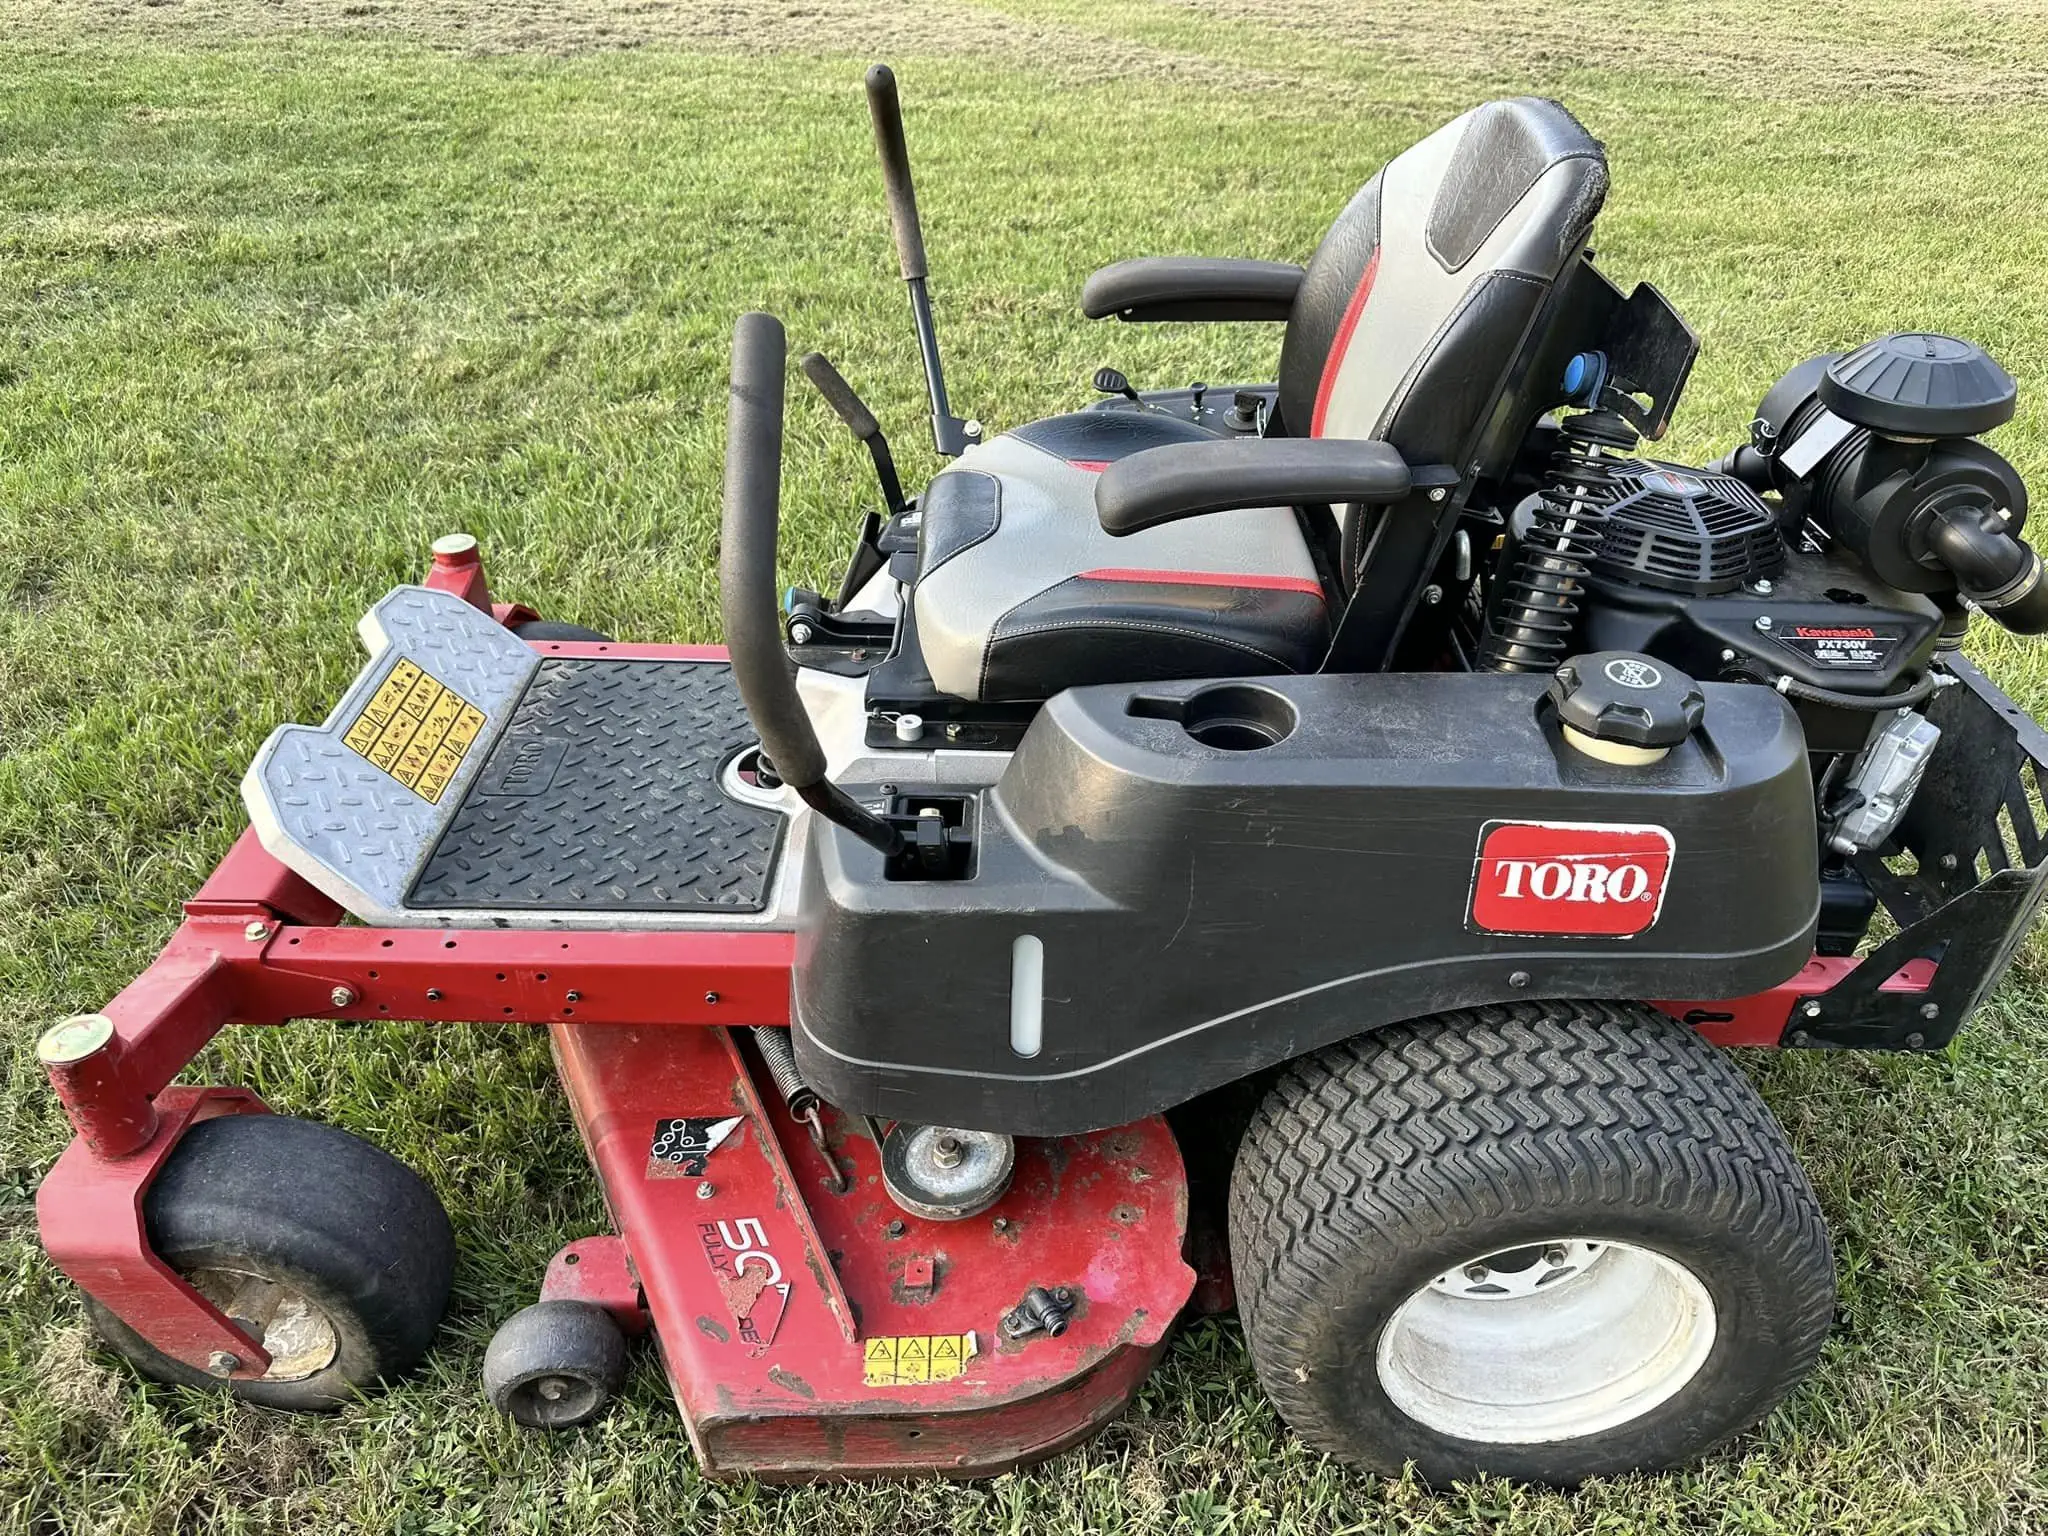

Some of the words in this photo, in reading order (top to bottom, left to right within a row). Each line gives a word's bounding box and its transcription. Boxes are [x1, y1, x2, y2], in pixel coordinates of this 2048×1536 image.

[1795, 627, 1875, 638] Kawasaki
[1817, 640, 1867, 649] FX730V
[500, 741, 544, 790] TORO
[697, 1223, 732, 1273] FULLY
